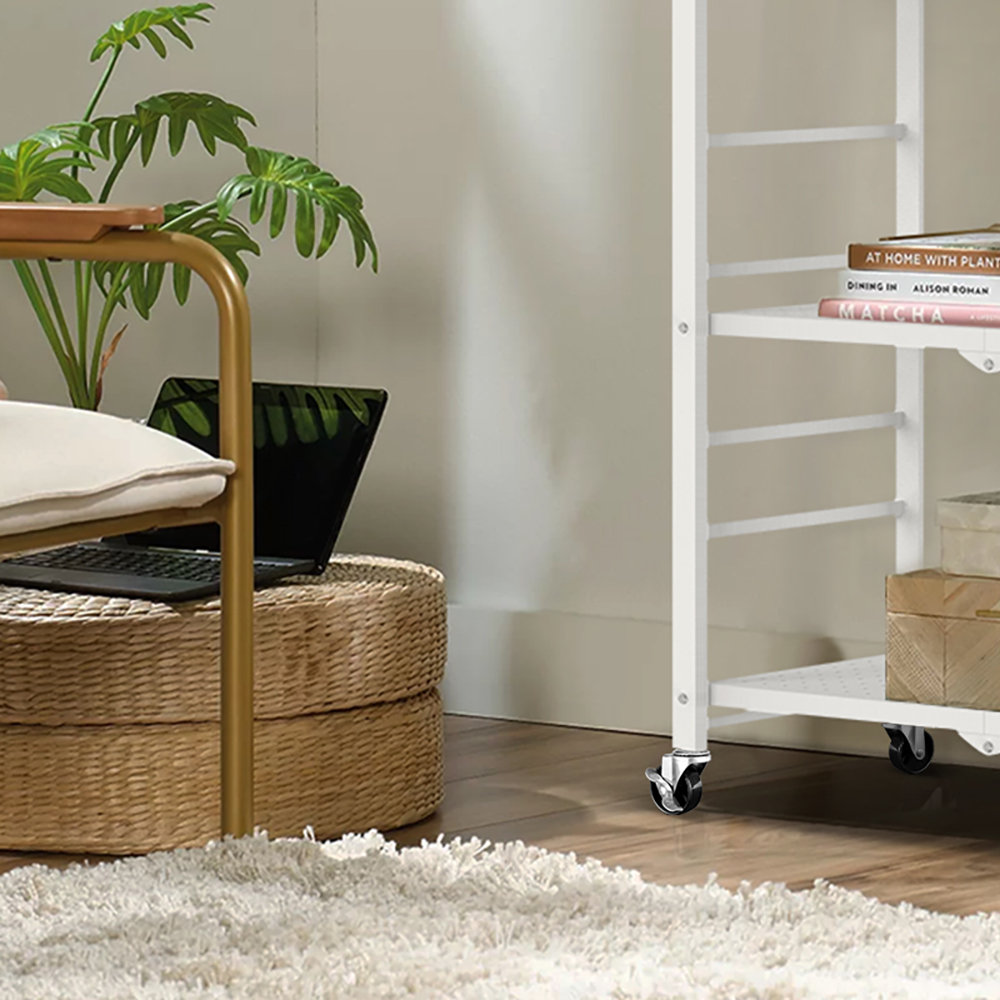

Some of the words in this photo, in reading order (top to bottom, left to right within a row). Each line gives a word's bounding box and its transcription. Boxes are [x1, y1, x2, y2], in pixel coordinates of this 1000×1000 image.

[866, 252, 881, 263] AT
[885, 252, 921, 265] HOME
[925, 254, 957, 267] WITH
[847, 281, 884, 291] DINING
[886, 283, 897, 291] IN
[912, 284, 950, 294] ALISON
[952, 285, 989, 295] ROMAN
[838, 303, 944, 323] MATCHA
